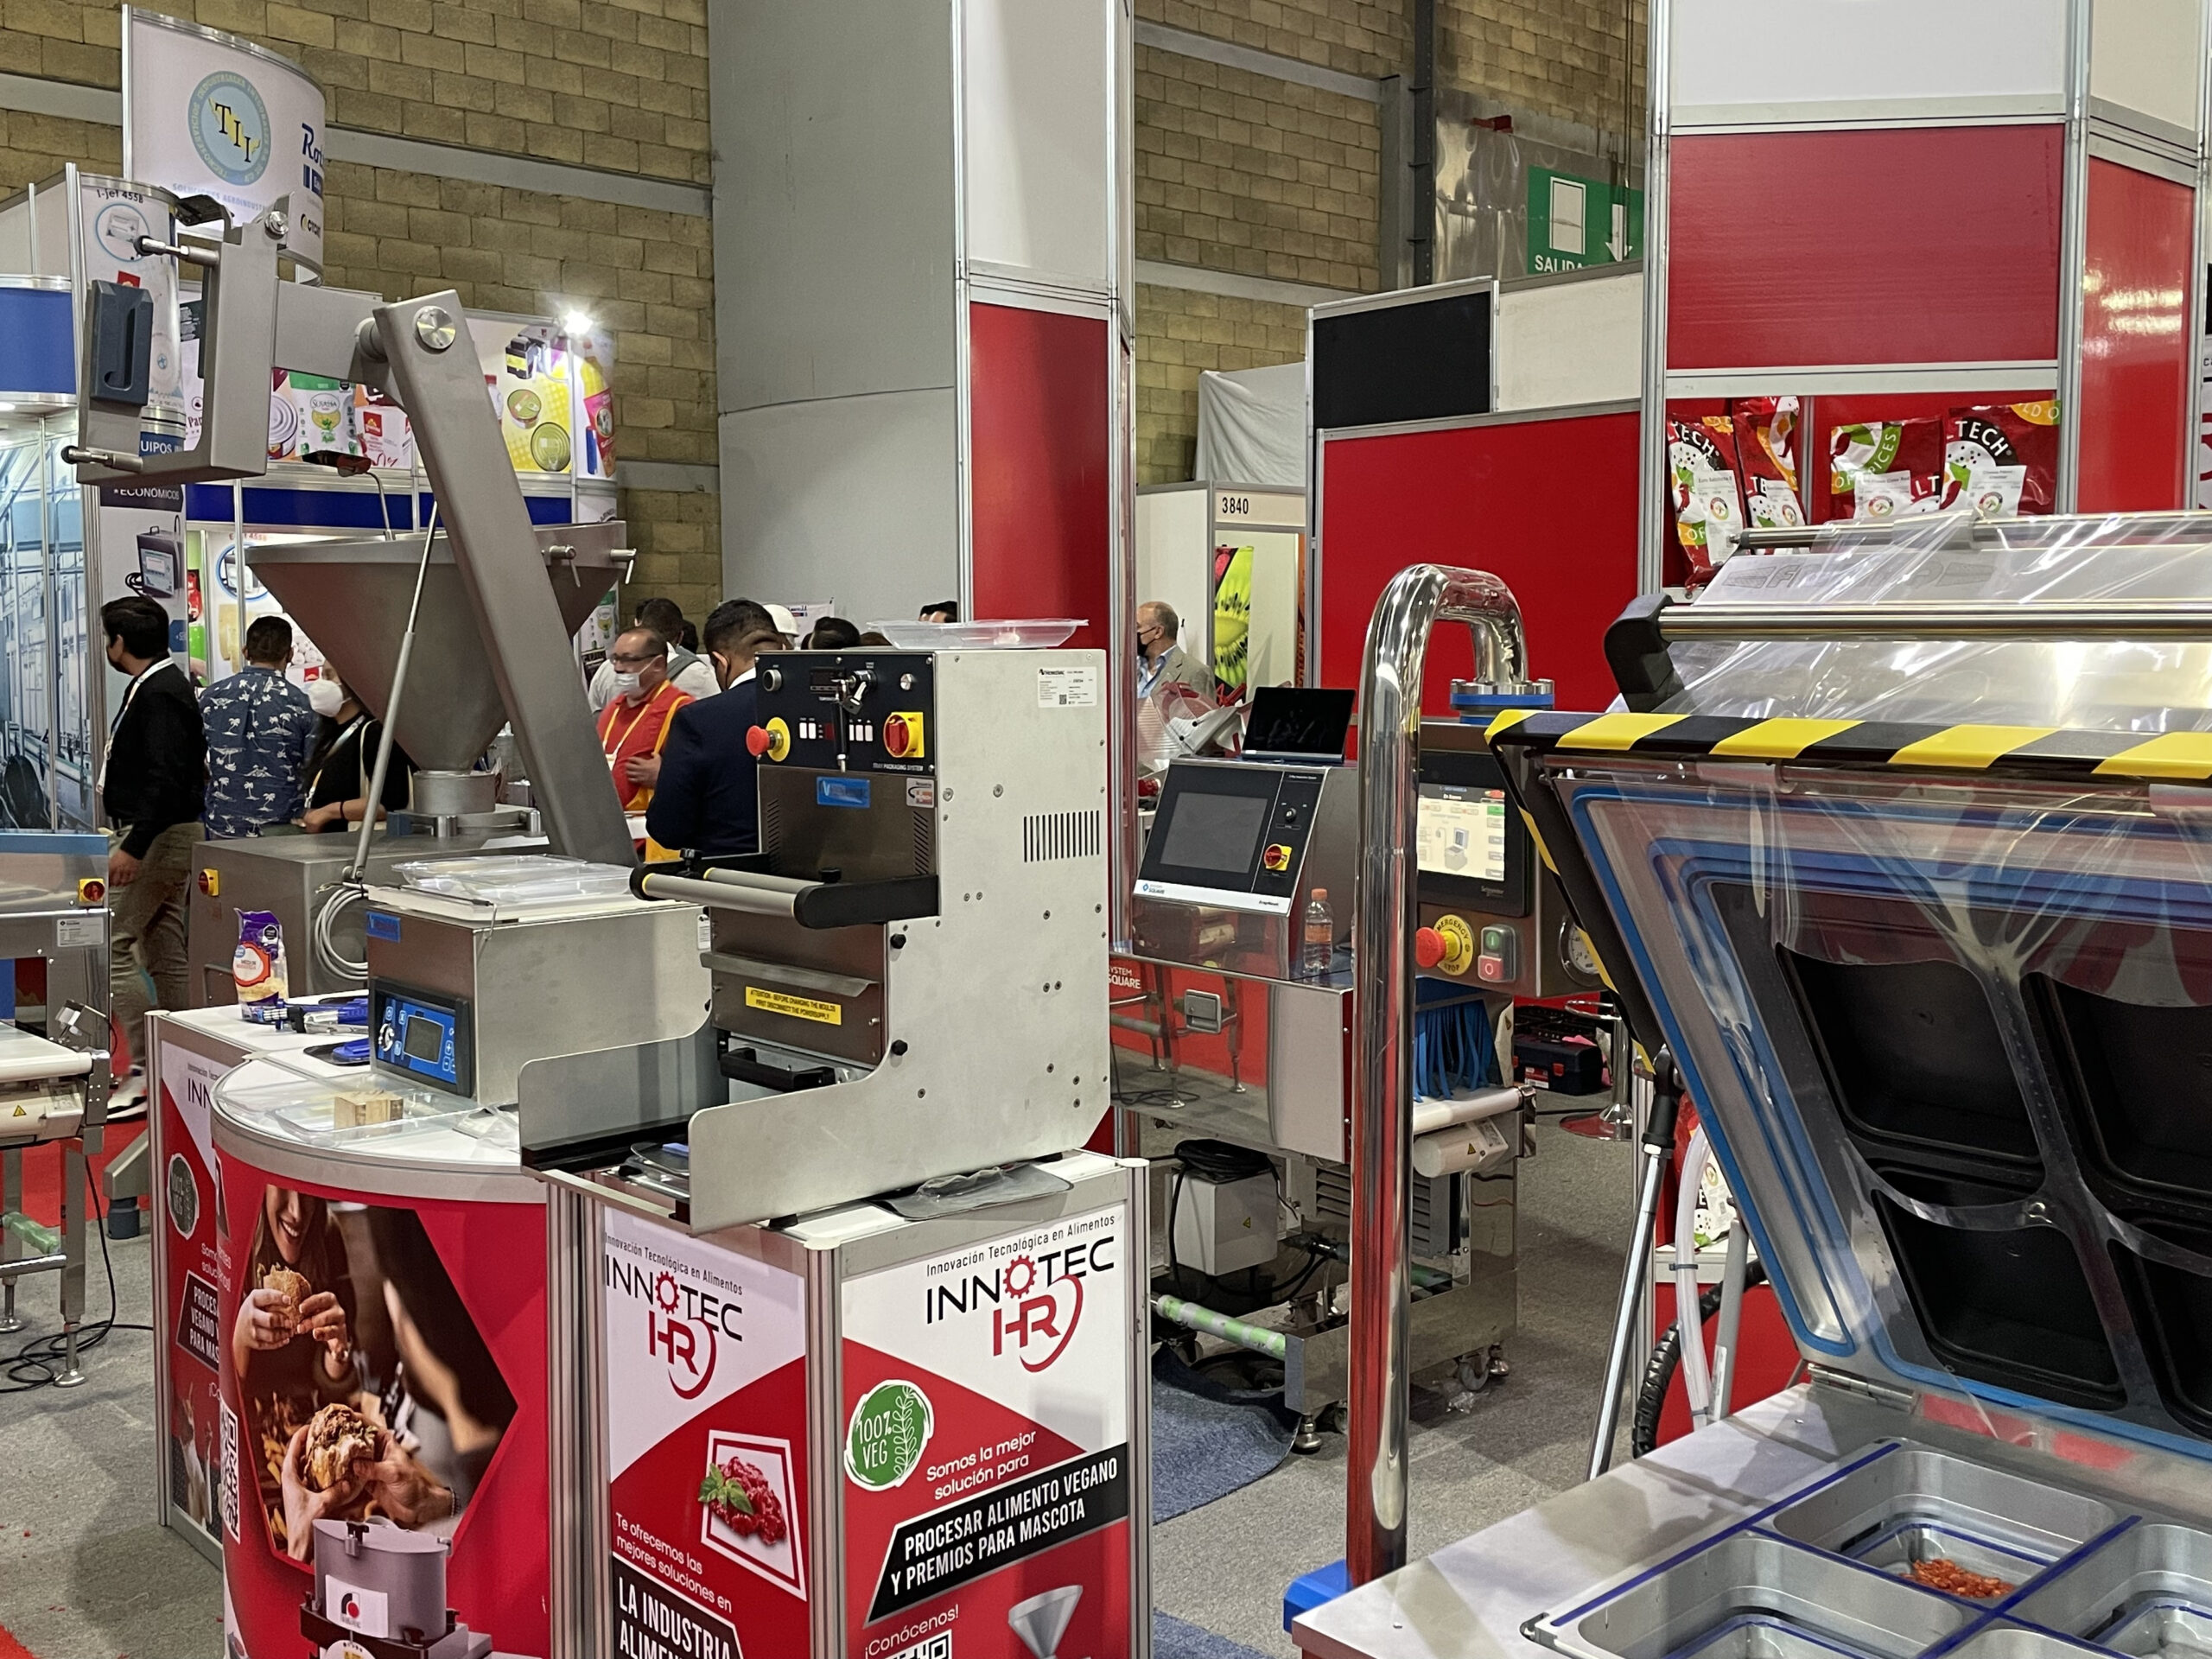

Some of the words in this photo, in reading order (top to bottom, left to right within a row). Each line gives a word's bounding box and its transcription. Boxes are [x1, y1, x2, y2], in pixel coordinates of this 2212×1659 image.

[1222, 497, 1249, 514] 3840
[645, 1246, 689, 1274] Tecnológica
[690, 1267, 701, 1280] en
[702, 1269, 743, 1295] Alimentos
[926, 1250, 984, 1277] Innovación
[988, 1234, 1049, 1260] Tecnológica
[1052, 1229, 1064, 1242] en
[1067, 1215, 1115, 1236] Alimentos
[606, 1254, 743, 1342] INNOTEC
[927, 1236, 1115, 1325] INNOTEC
[189, 1328, 206, 1354] PARA
[190, 1306, 215, 1338] VEGANO
[856, 1410, 893, 1445] 100%
[862, 1439, 888, 1470] VEG
[926, 1452, 976, 1482] Somos
[980, 1446, 993, 1462] la
[996, 1431, 1037, 1457] mejor
[934, 1465, 994, 1501] solución
[997, 1454, 1029, 1480] para
[905, 1509, 983, 1561] PROCESAR
[987, 1479, 1059, 1528] ALIMENTO
[1064, 1457, 1117, 1497] VEGANO
[615, 1512, 628, 1531] Te
[630, 1523, 684, 1565] ofrecemos
[686, 1553, 702, 1575] las
[891, 1570, 901, 1596] Y
[907, 1541, 974, 1591] PREMIOS
[978, 1525, 1015, 1560] PARA
[1020, 1497, 1086, 1543] MASCOTA
[616, 1535, 657, 1569] mejores
[658, 1560, 715, 1604] soluciones
[717, 1595, 733, 1614] en
[619, 1576, 639, 1619] LA
[865, 1603, 959, 1659] ¡Conócenos!
